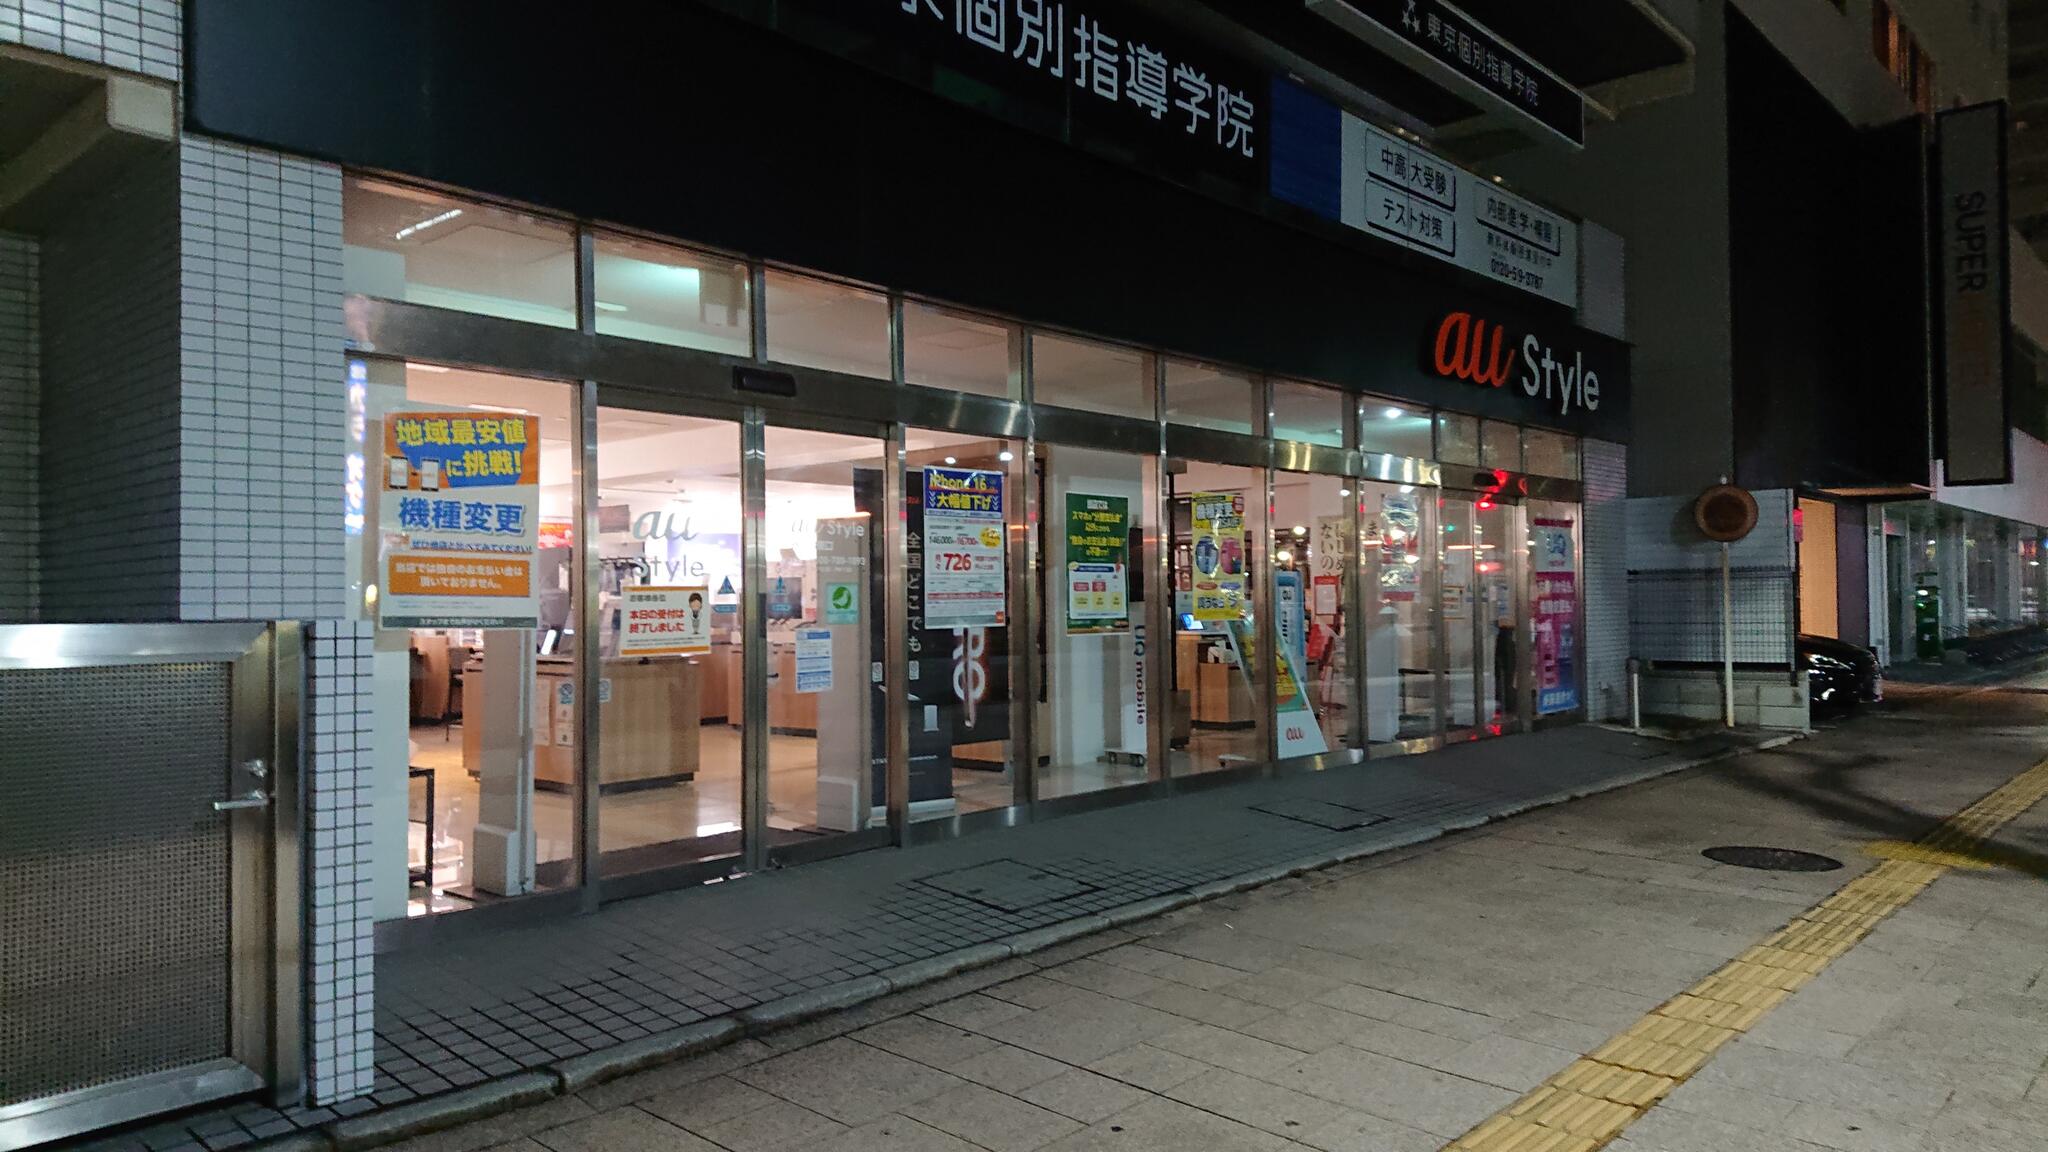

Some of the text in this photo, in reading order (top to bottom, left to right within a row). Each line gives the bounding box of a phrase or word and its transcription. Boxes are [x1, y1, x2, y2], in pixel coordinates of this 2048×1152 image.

[1425, 12, 1540, 109] 東京個別指導学院
[1383, 197, 1443, 243] テスト対策
[1955, 191, 1987, 293] SUPER
[1434, 310, 1600, 416] au Style
[395, 418, 527, 446] 地域最安値
[398, 496, 524, 534] 機種変更
[632, 510, 698, 542] au
[944, 553, 977, 572] 726
[629, 609, 685, 620] 本日の受付は
[629, 622, 685, 634] 終了しました
[1135, 660, 1146, 725] mobile
